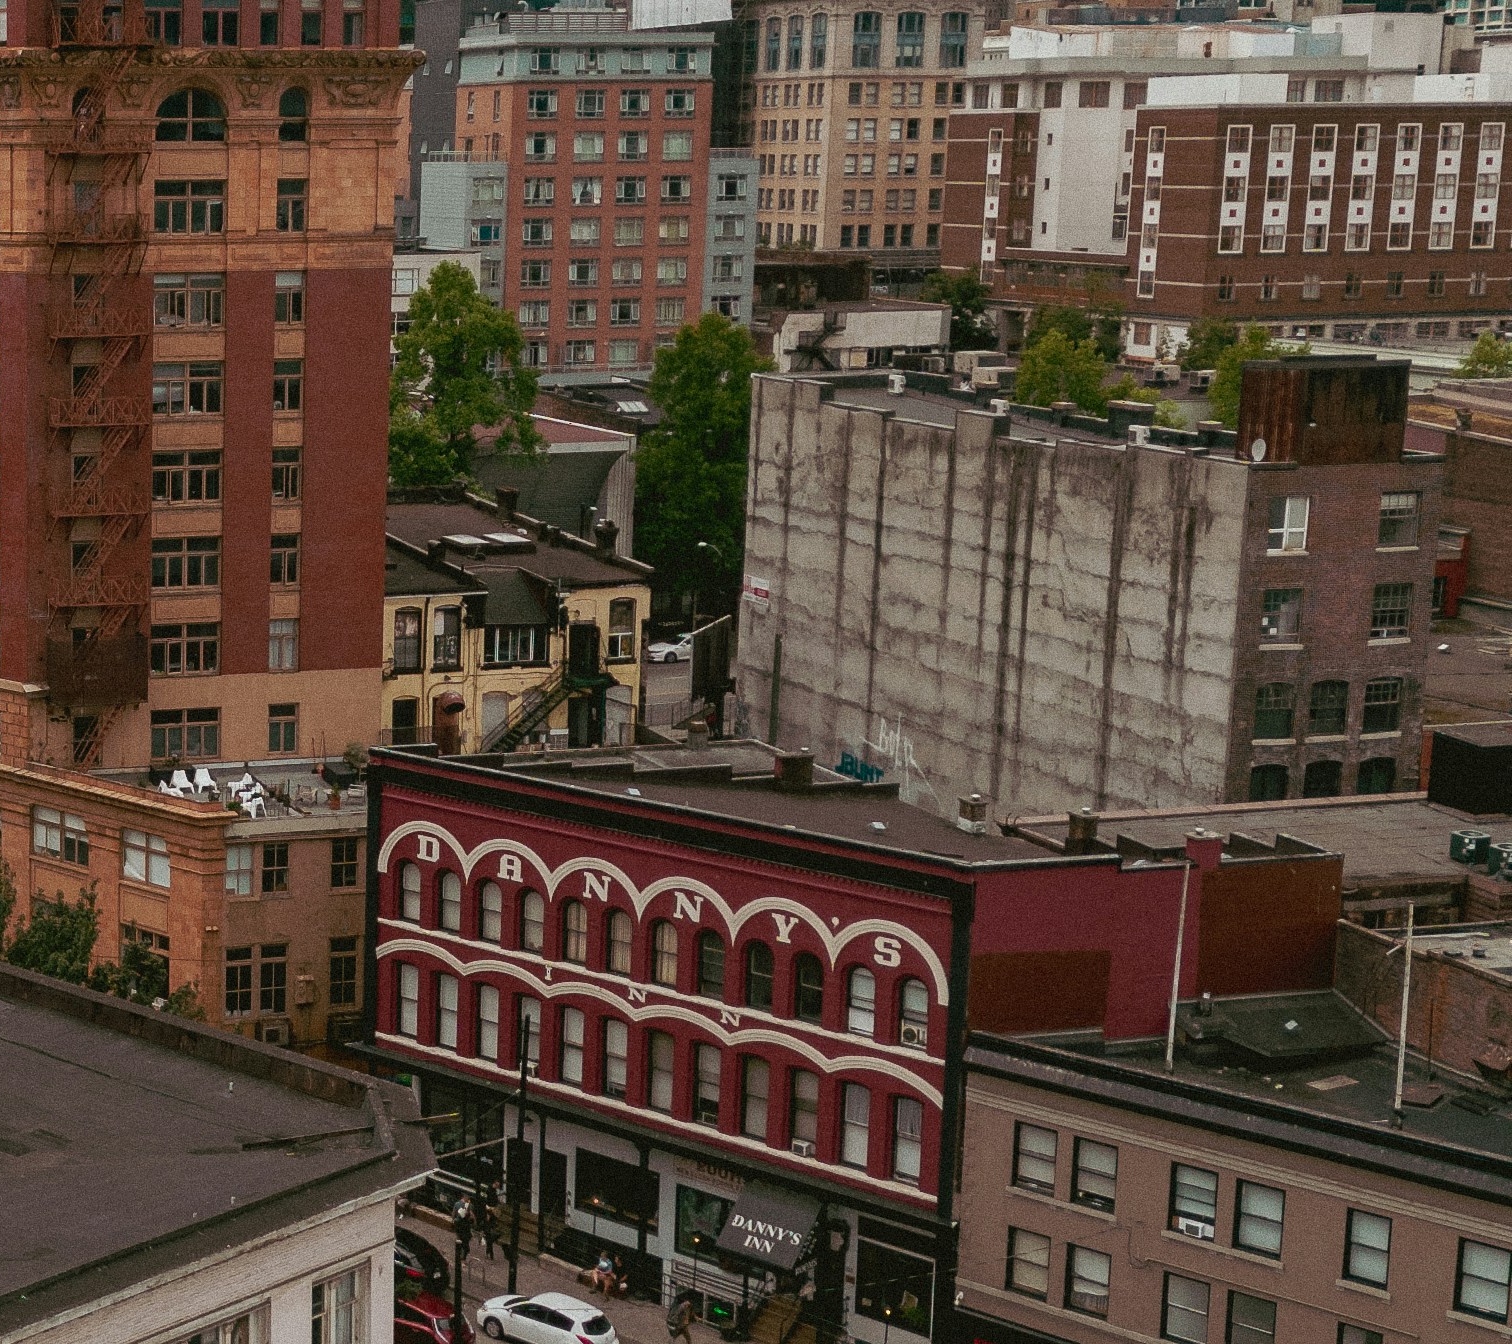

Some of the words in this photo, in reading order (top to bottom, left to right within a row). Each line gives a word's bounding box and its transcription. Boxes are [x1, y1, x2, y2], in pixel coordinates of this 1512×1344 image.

[415, 833, 903, 969] DANNY'S
[544, 964, 740, 1027] INN
[731, 1213, 803, 1246] DANNY'S
[743, 1234, 775, 1254] INN
